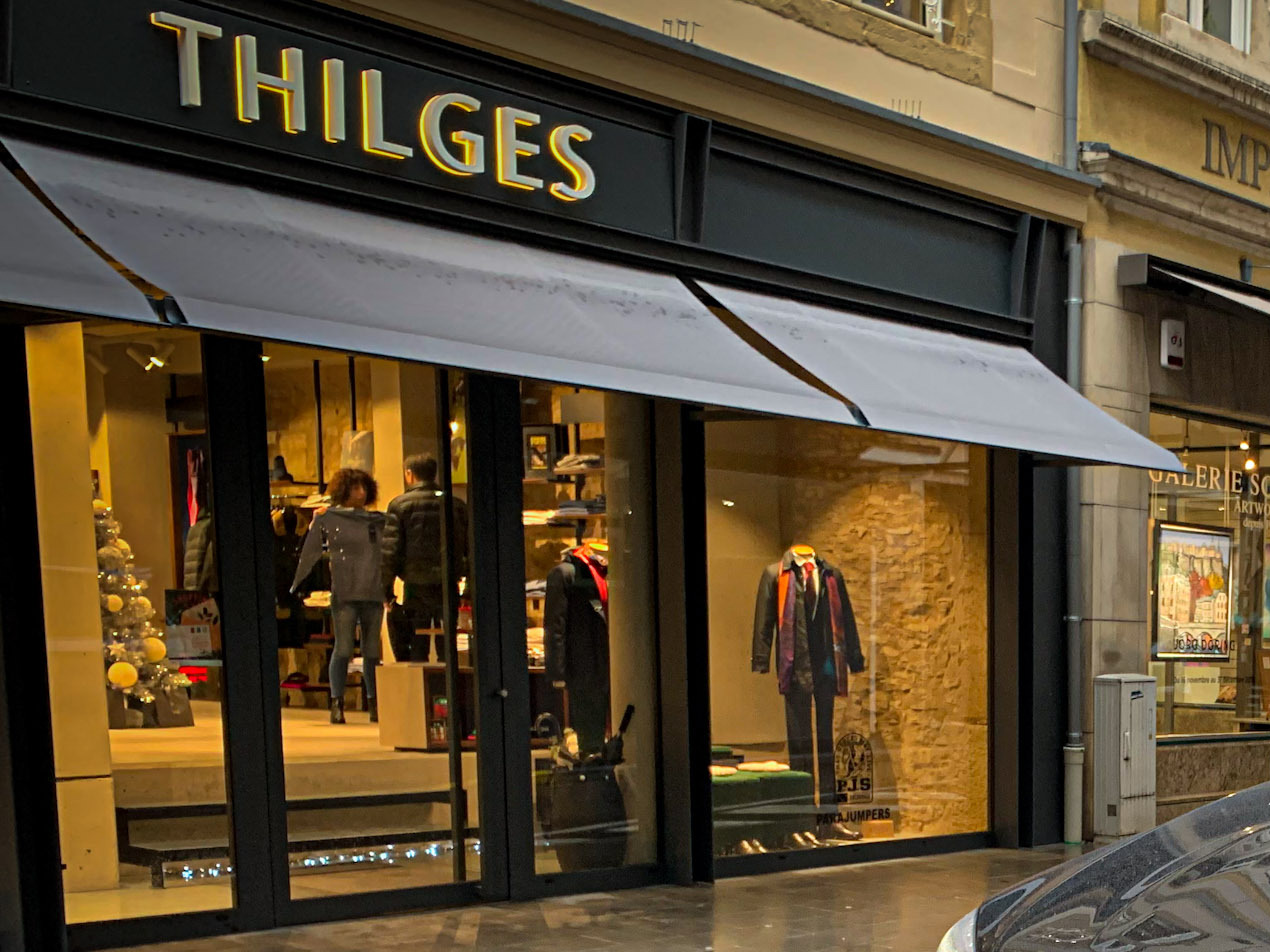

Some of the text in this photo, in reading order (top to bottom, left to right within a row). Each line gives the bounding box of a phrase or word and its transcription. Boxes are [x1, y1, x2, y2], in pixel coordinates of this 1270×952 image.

[150, 10, 596, 201] THILGES
[1149, 463, 1243, 493] GALERIE
[837, 777, 871, 792] PJS
[816, 807, 891, 825] PARAJUMPERS
